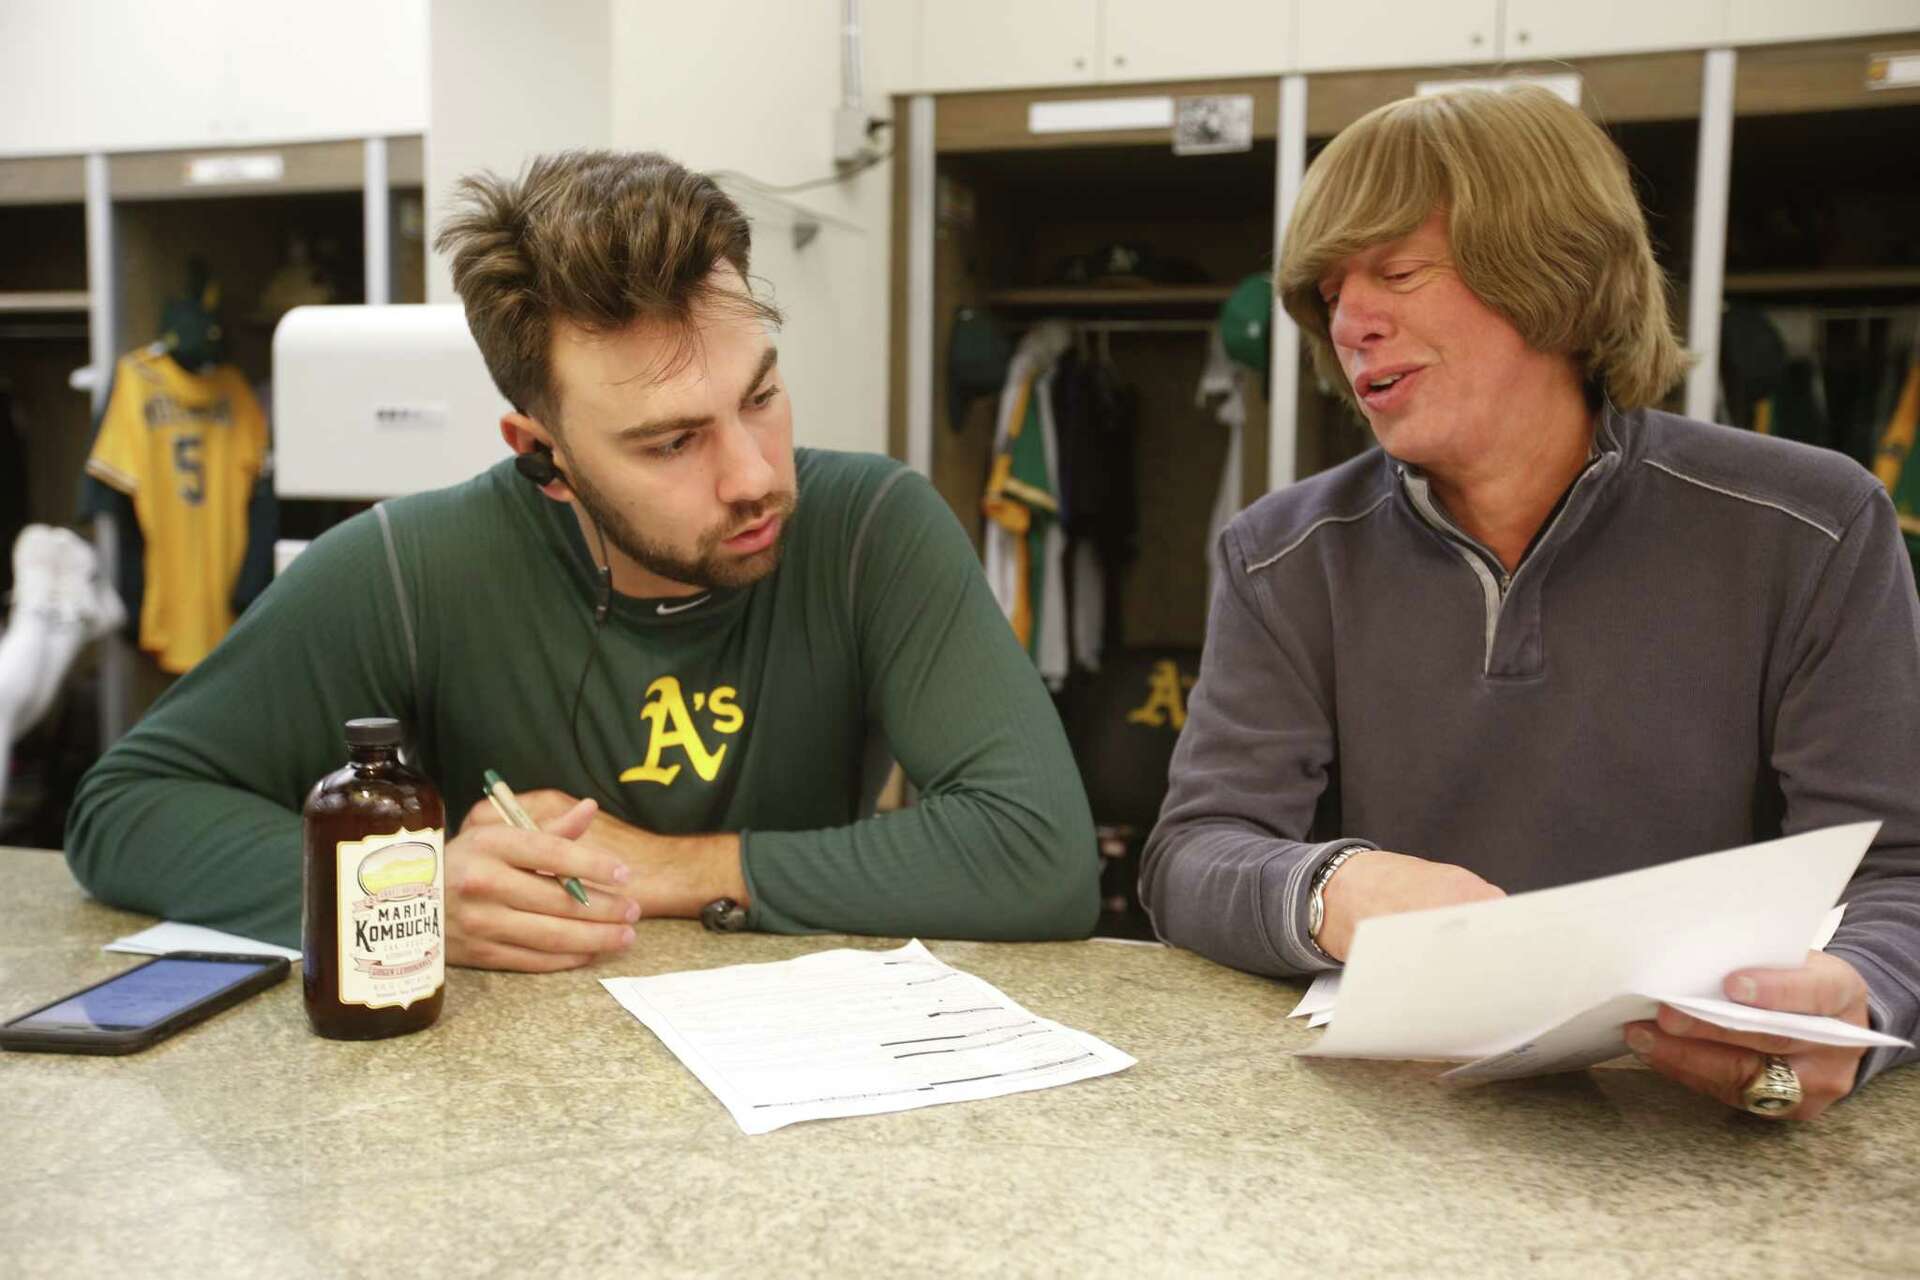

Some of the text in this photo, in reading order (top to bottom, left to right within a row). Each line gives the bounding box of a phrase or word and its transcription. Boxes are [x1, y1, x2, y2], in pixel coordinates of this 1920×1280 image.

[174, 436, 206, 504] 5
[618, 675, 744, 786] A's
[356, 907, 440, 952] KOMBUCHA
[378, 902, 427, 921] MARIN
